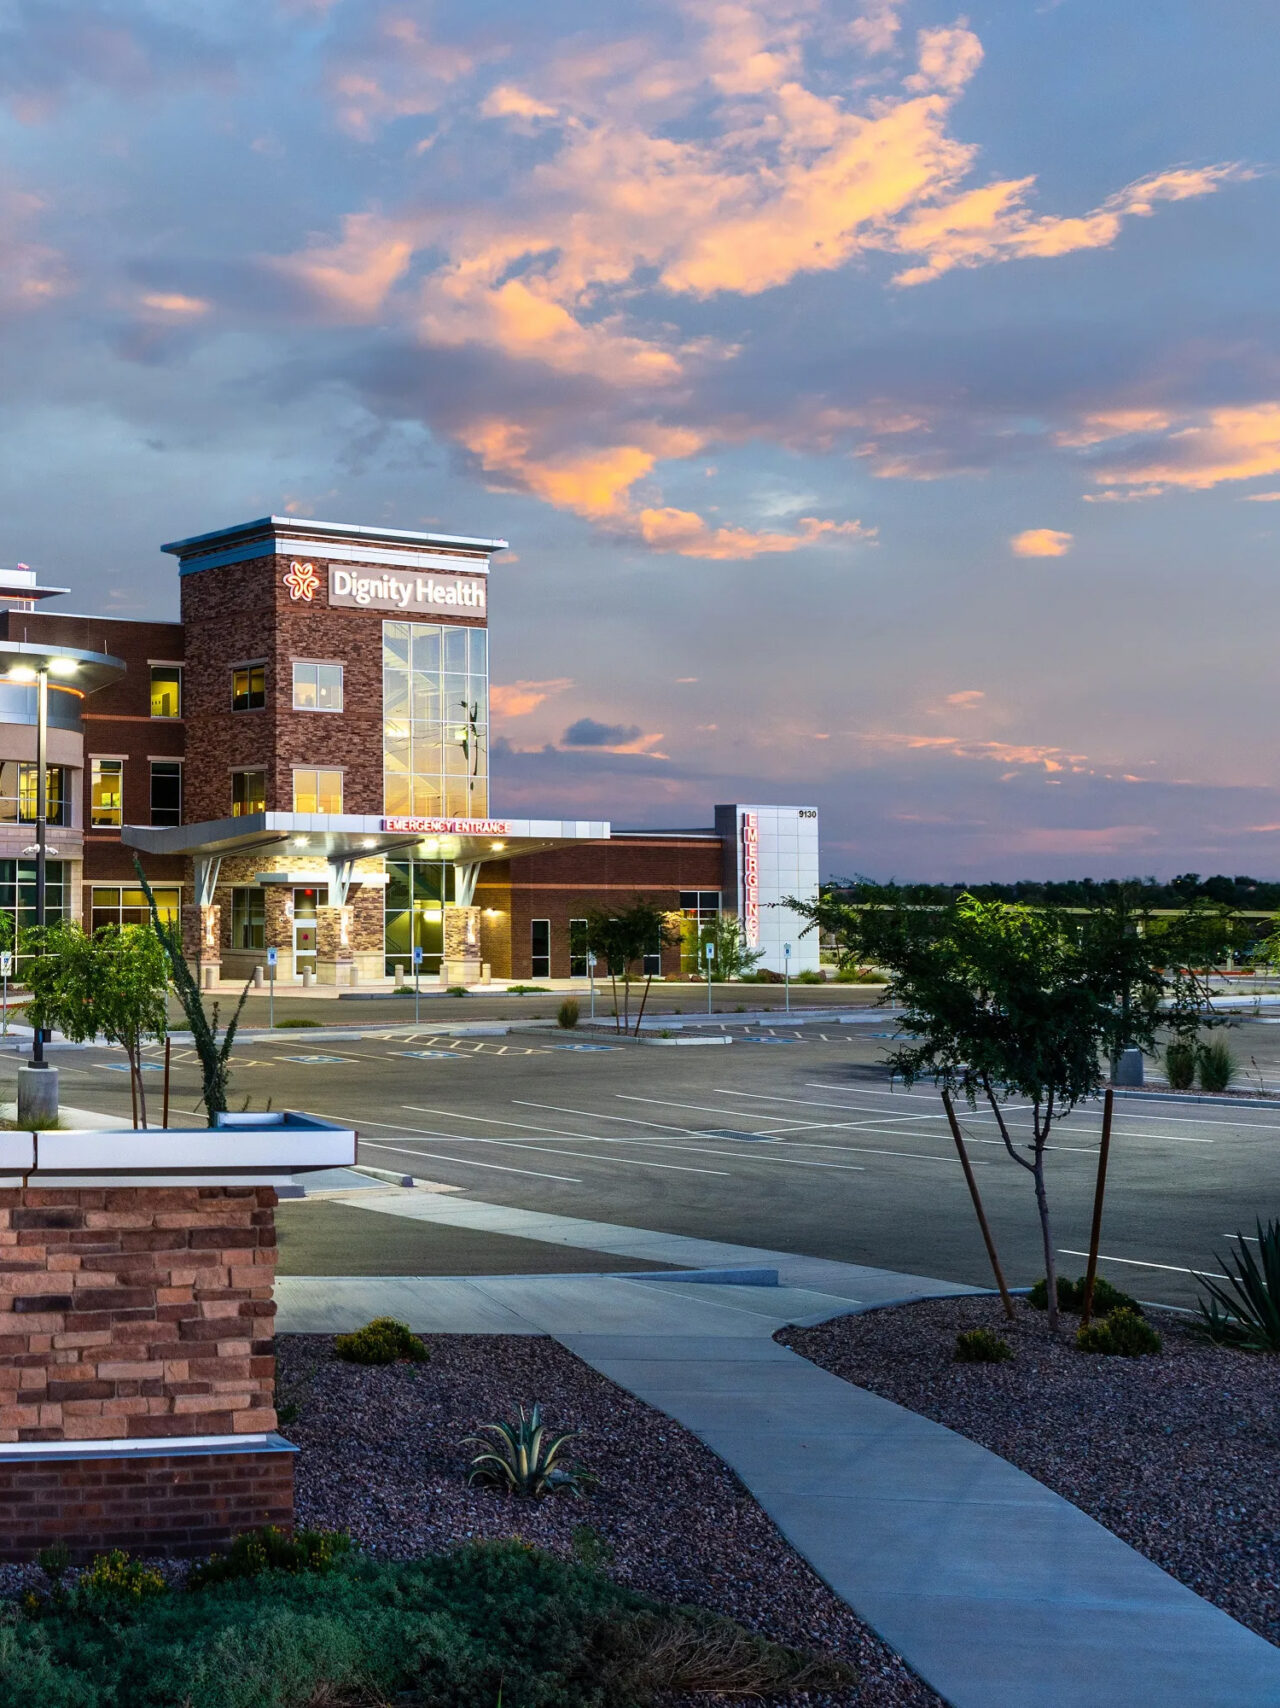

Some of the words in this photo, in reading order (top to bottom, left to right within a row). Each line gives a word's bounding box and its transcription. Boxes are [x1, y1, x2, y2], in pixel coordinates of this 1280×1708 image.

[333, 571, 413, 607] Dignity
[416, 578, 485, 607] Health
[386, 819, 452, 833] EMERGENCY
[455, 820, 512, 834] ENTRANCE
[799, 810, 817, 818] 9130
[745, 812, 759, 947] EMERGENCY
